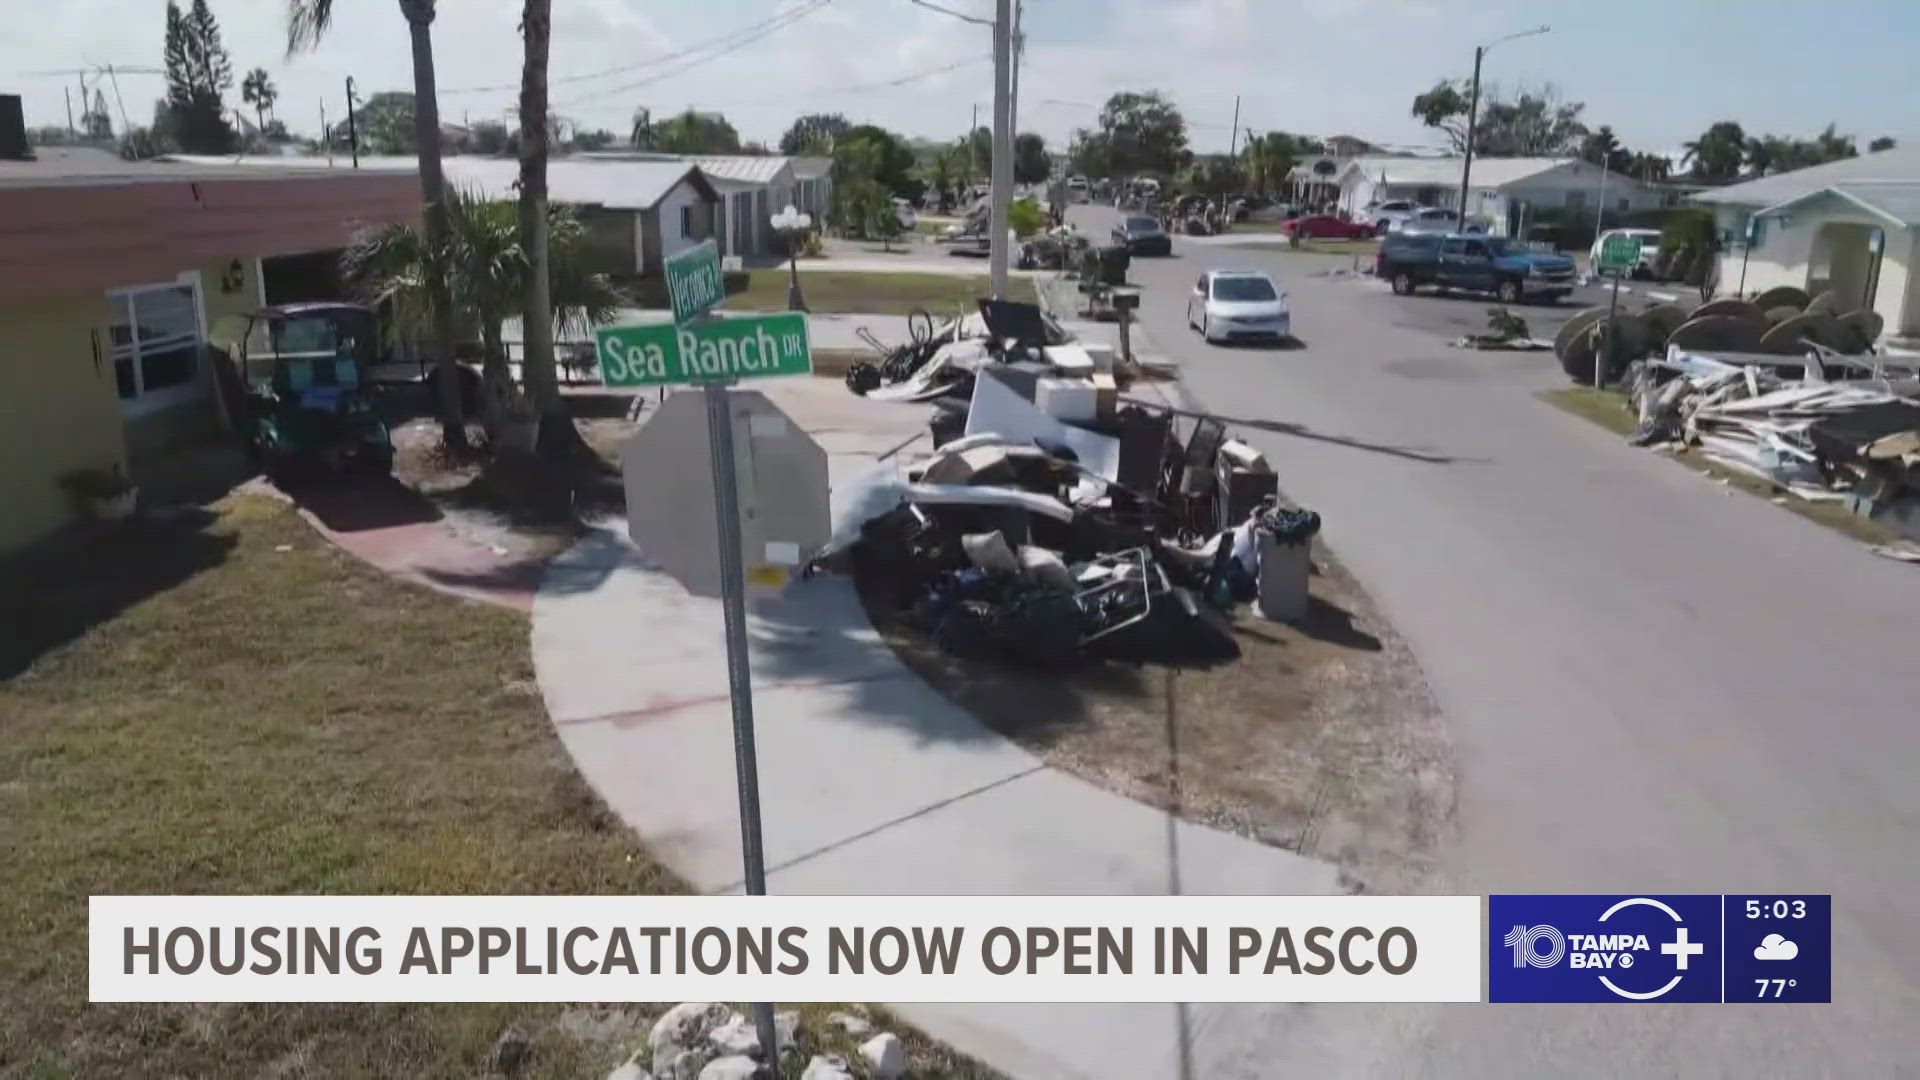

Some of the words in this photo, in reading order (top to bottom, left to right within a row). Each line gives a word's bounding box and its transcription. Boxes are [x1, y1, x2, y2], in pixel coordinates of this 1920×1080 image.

[605, 336, 666, 381] Sea
[677, 325, 779, 376] Ranch
[782, 333, 802, 357] DR
